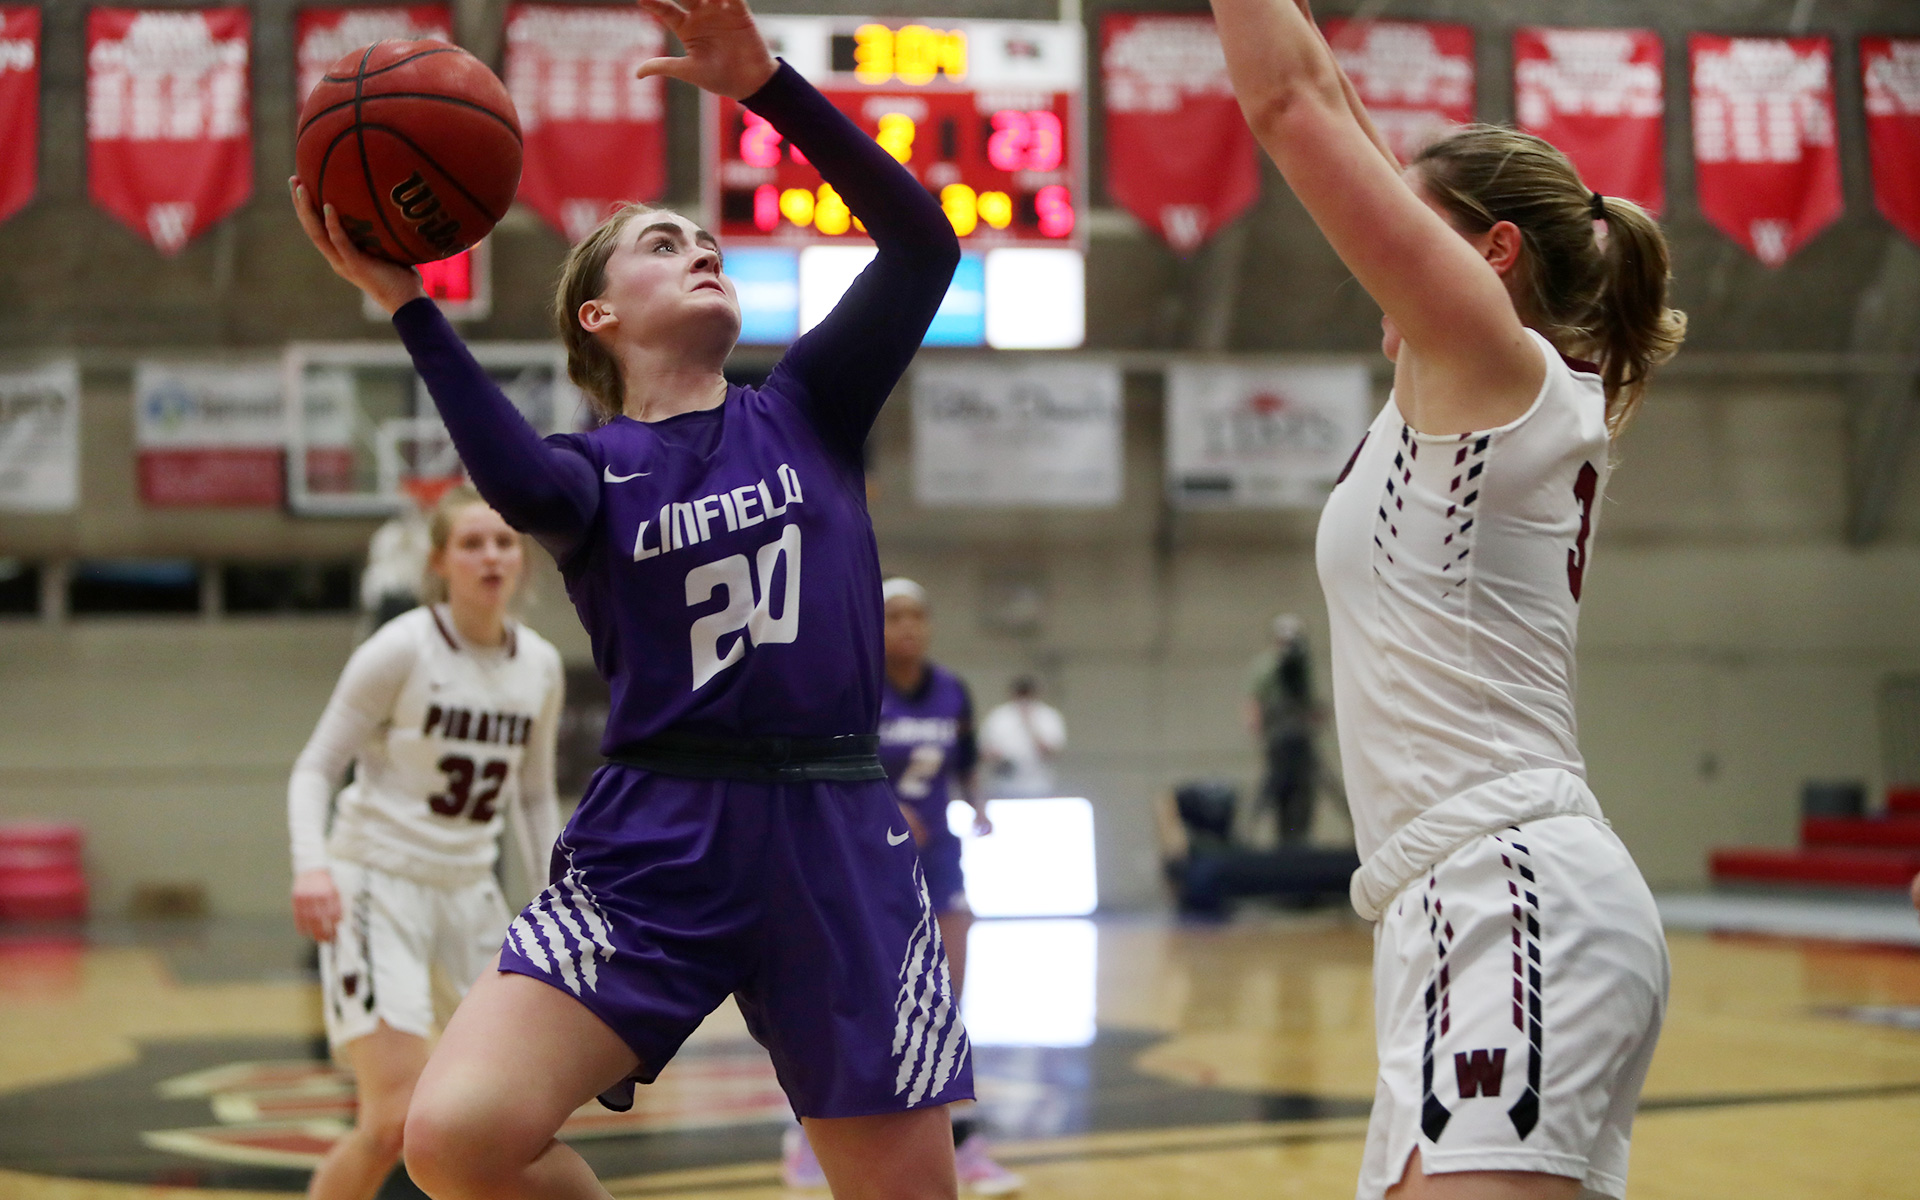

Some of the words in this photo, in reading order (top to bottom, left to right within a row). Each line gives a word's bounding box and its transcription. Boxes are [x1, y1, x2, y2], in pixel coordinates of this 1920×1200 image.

[634, 463, 803, 562] LINFIELD
[685, 523, 801, 692] 20
[427, 755, 508, 822] 32
[898, 746, 945, 798] 2
[1453, 1048, 1507, 1099] W
